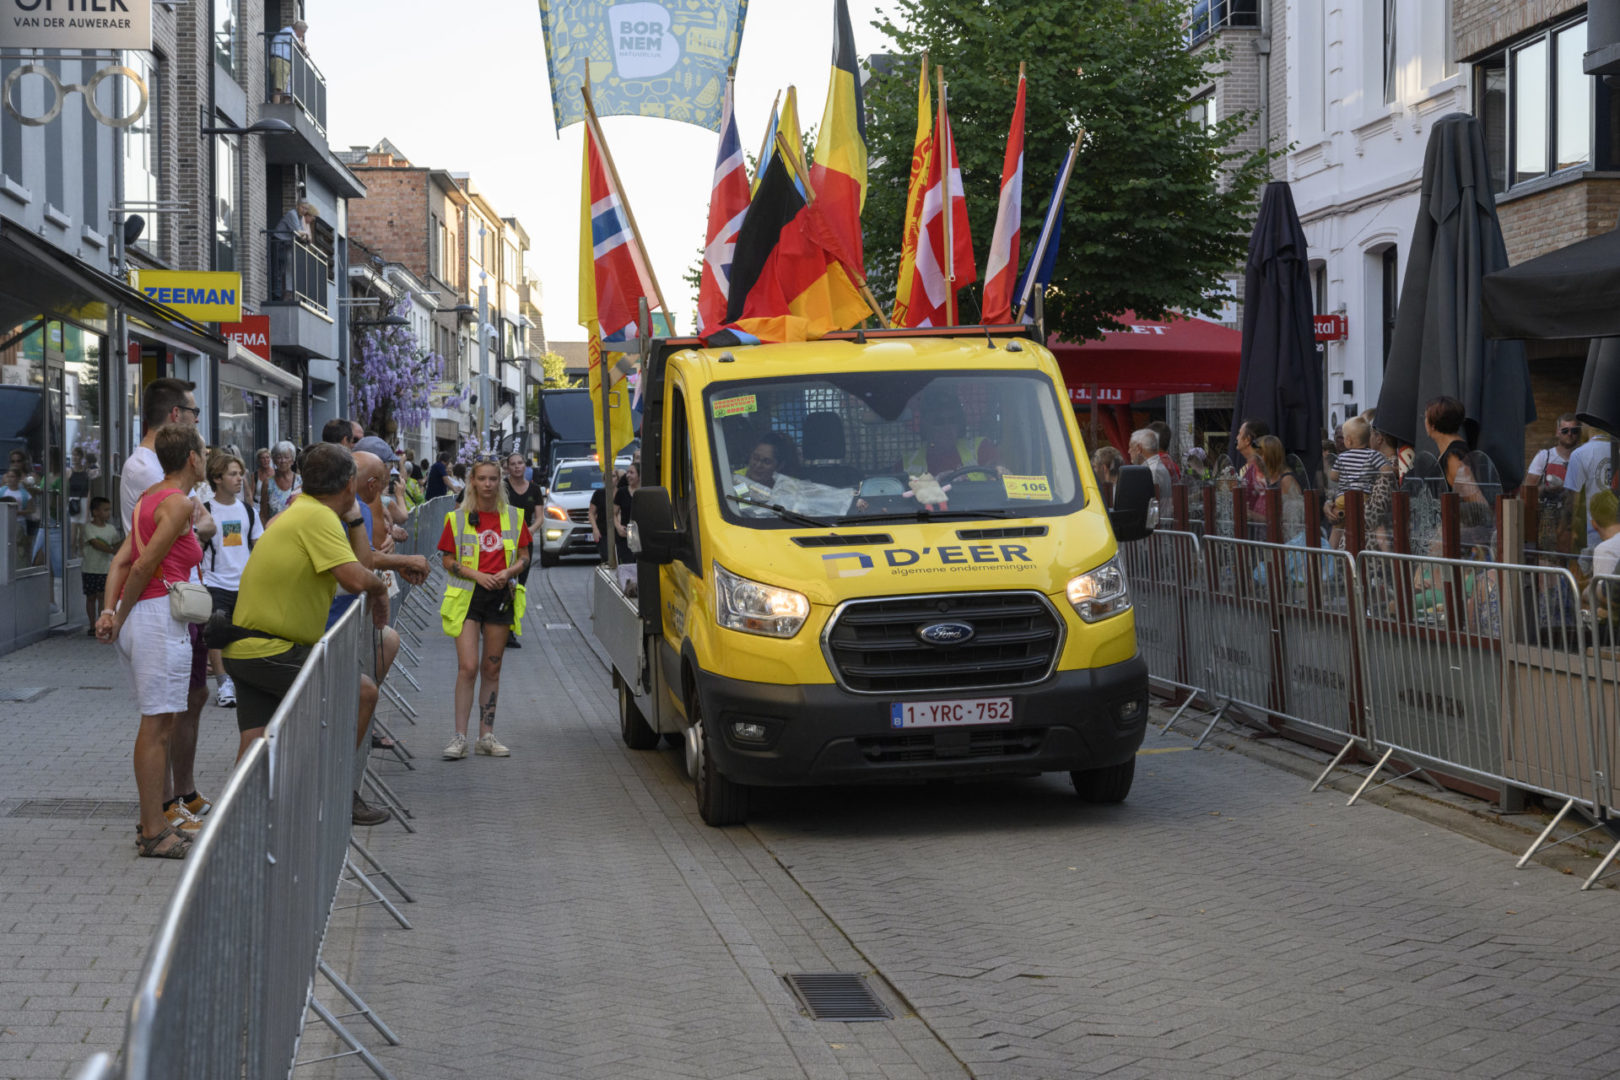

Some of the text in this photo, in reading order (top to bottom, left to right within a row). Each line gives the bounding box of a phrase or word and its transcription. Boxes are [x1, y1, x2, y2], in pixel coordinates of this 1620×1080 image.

[14, 17, 131, 28] VAN DER AUWERAER
[620, 21, 664, 36] BOR
[620, 36, 662, 51] NEM
[143, 287, 235, 305] ZEEMAN
[1021, 482, 1047, 492] 106
[884, 545, 1033, 567] D'EER
[891, 563, 1037, 577] algemene ondernemingen
[934, 627, 962, 639] Ford
